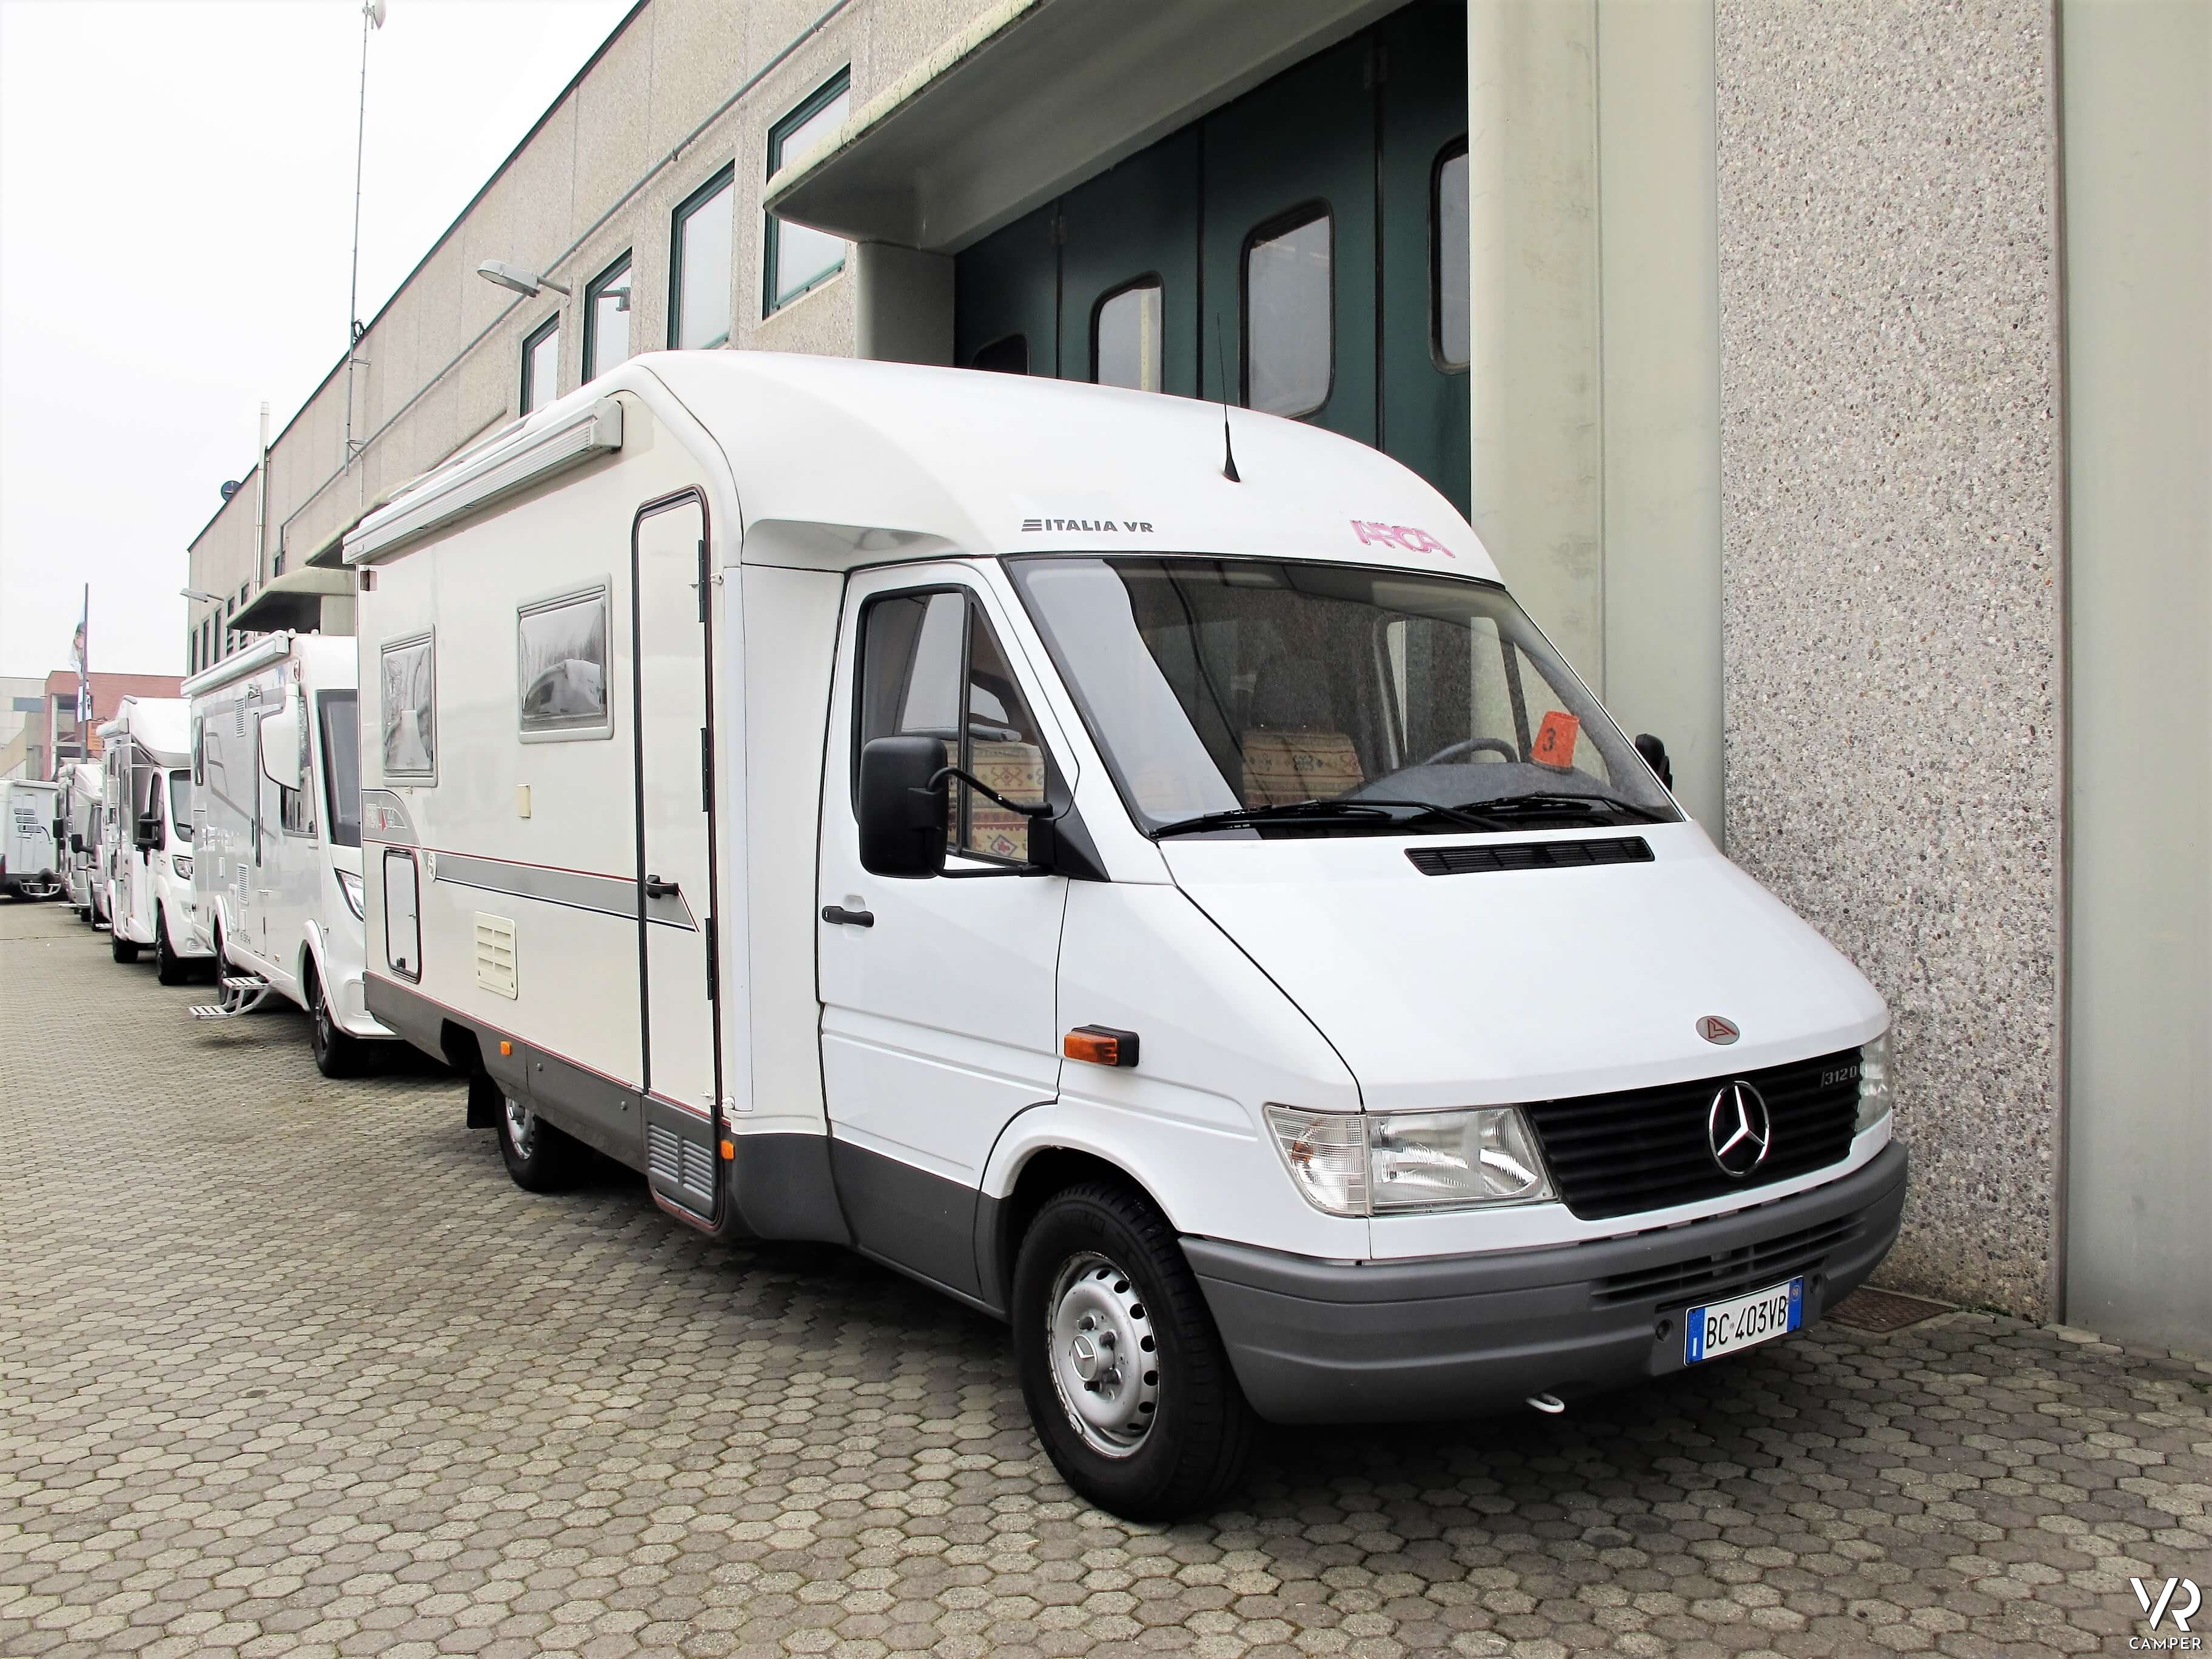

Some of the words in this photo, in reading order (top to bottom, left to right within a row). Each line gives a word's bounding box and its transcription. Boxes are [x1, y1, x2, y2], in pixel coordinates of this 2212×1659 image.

[1045, 519, 1118, 532] ITALIA
[1124, 521, 1155, 532] VR
[1350, 520, 1455, 558] ARCA
[1542, 727, 1556, 751] 3
